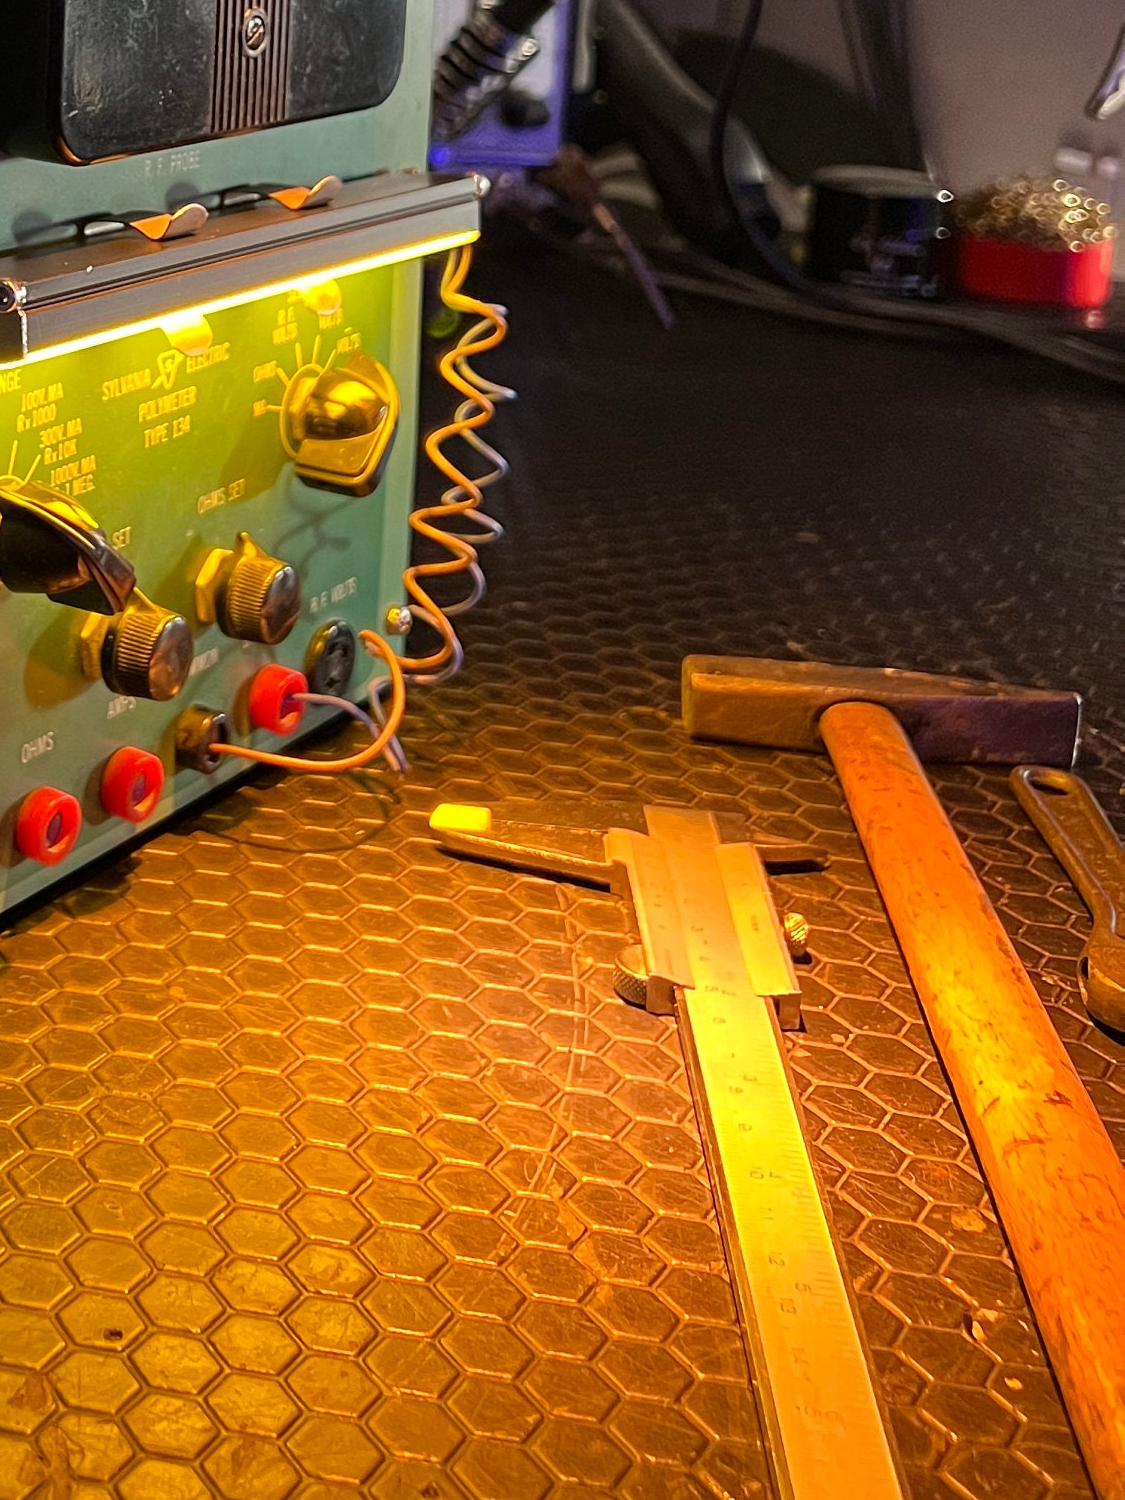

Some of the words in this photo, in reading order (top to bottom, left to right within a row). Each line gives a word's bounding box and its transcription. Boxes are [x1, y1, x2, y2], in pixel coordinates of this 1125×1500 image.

[101, 368, 152, 401] SYLVANIA
[139, 386, 198, 423] POLYMETER
[143, 423, 169, 448] TYPE
[197, 487, 226, 515] OHMS
[228, 478, 246, 501] SET
[21, 731, 55, 763] OHMS
[768, 1251, 786, 1267] 12
[779, 1297, 797, 1315] 13
